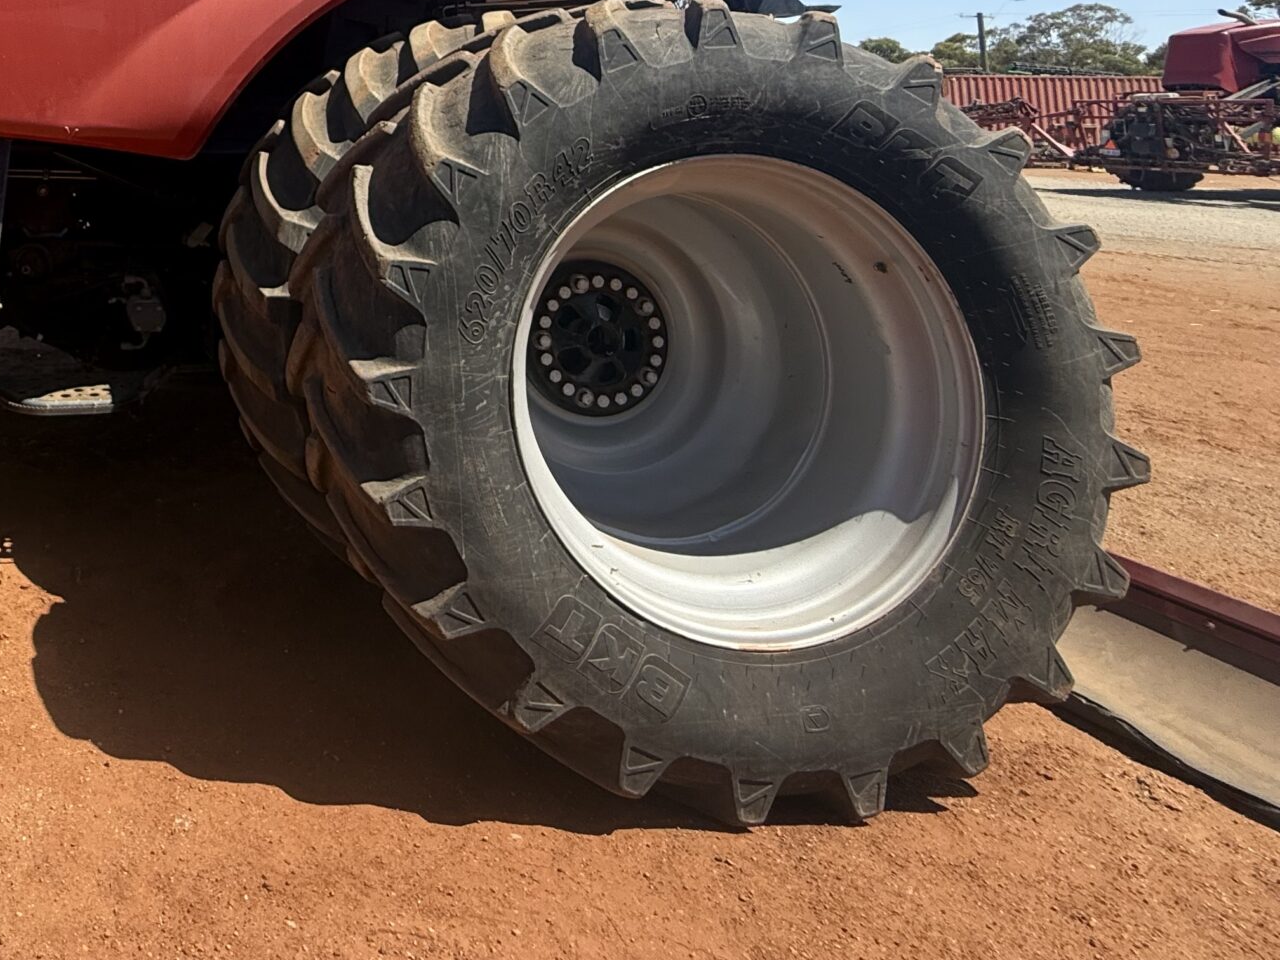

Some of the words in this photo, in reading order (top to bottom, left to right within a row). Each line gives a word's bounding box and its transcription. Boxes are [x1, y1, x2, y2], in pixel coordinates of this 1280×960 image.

[458, 137, 594, 344] 620/70R42
[985, 505, 1019, 560] RT
[959, 554, 999, 607] 765
[537, 602, 688, 722] BKT
